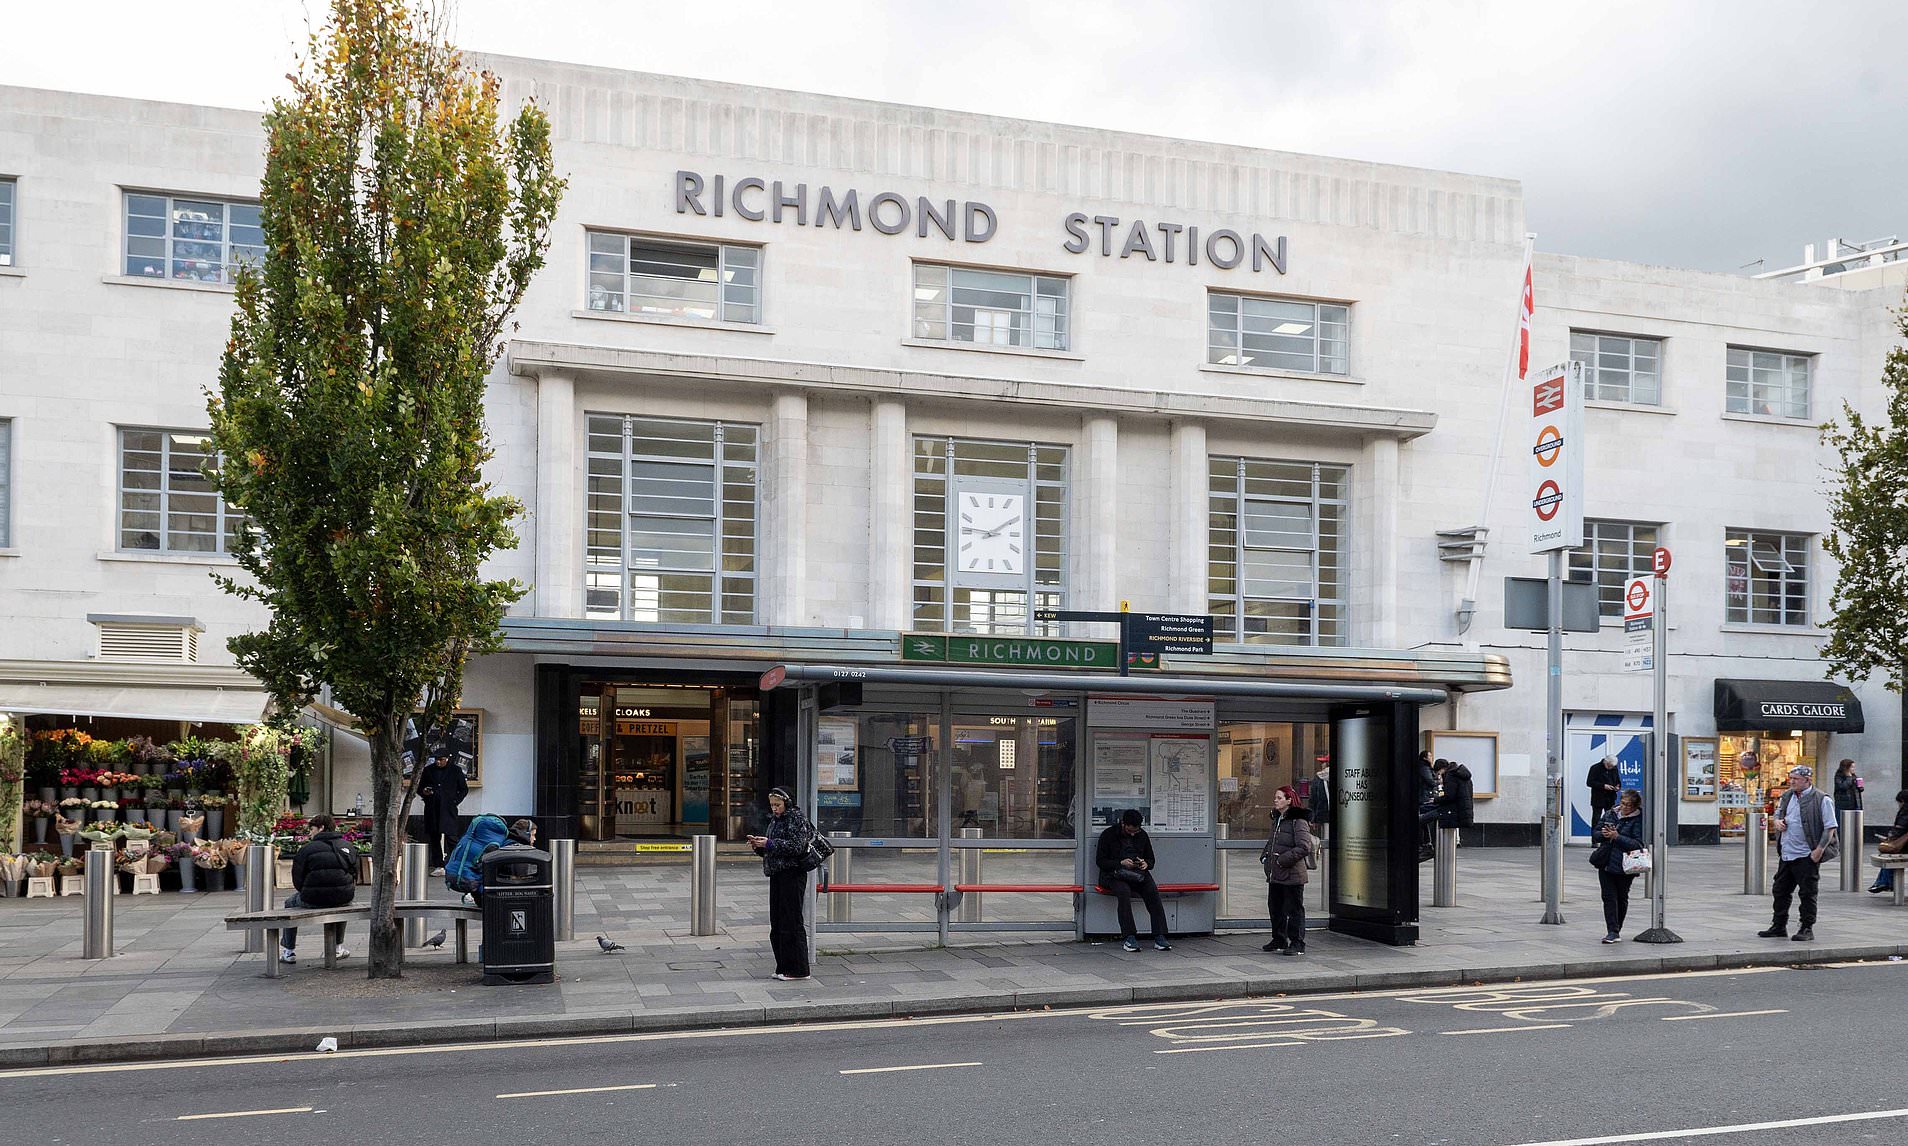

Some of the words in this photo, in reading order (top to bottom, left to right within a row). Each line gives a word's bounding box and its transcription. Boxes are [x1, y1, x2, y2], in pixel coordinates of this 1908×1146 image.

[676, 169, 998, 244] RICHMOND
[1063, 213, 1287, 275] STATION
[1534, 528, 1562, 543] Richmond
[1655, 551, 1664, 570] E
[969, 643, 1096, 662] RICHMOND
[1761, 705, 1799, 715] CARDS
[1802, 705, 1845, 716] GALORE
[630, 723, 668, 733] PRETZEL
[1344, 768, 1360, 778] STAFF
[1620, 760, 1641, 775] Heidi
[1356, 780, 1368, 789] HAS
[1395, 986, 1719, 1021] BUS
[1086, 1004, 1412, 1044] STOP
